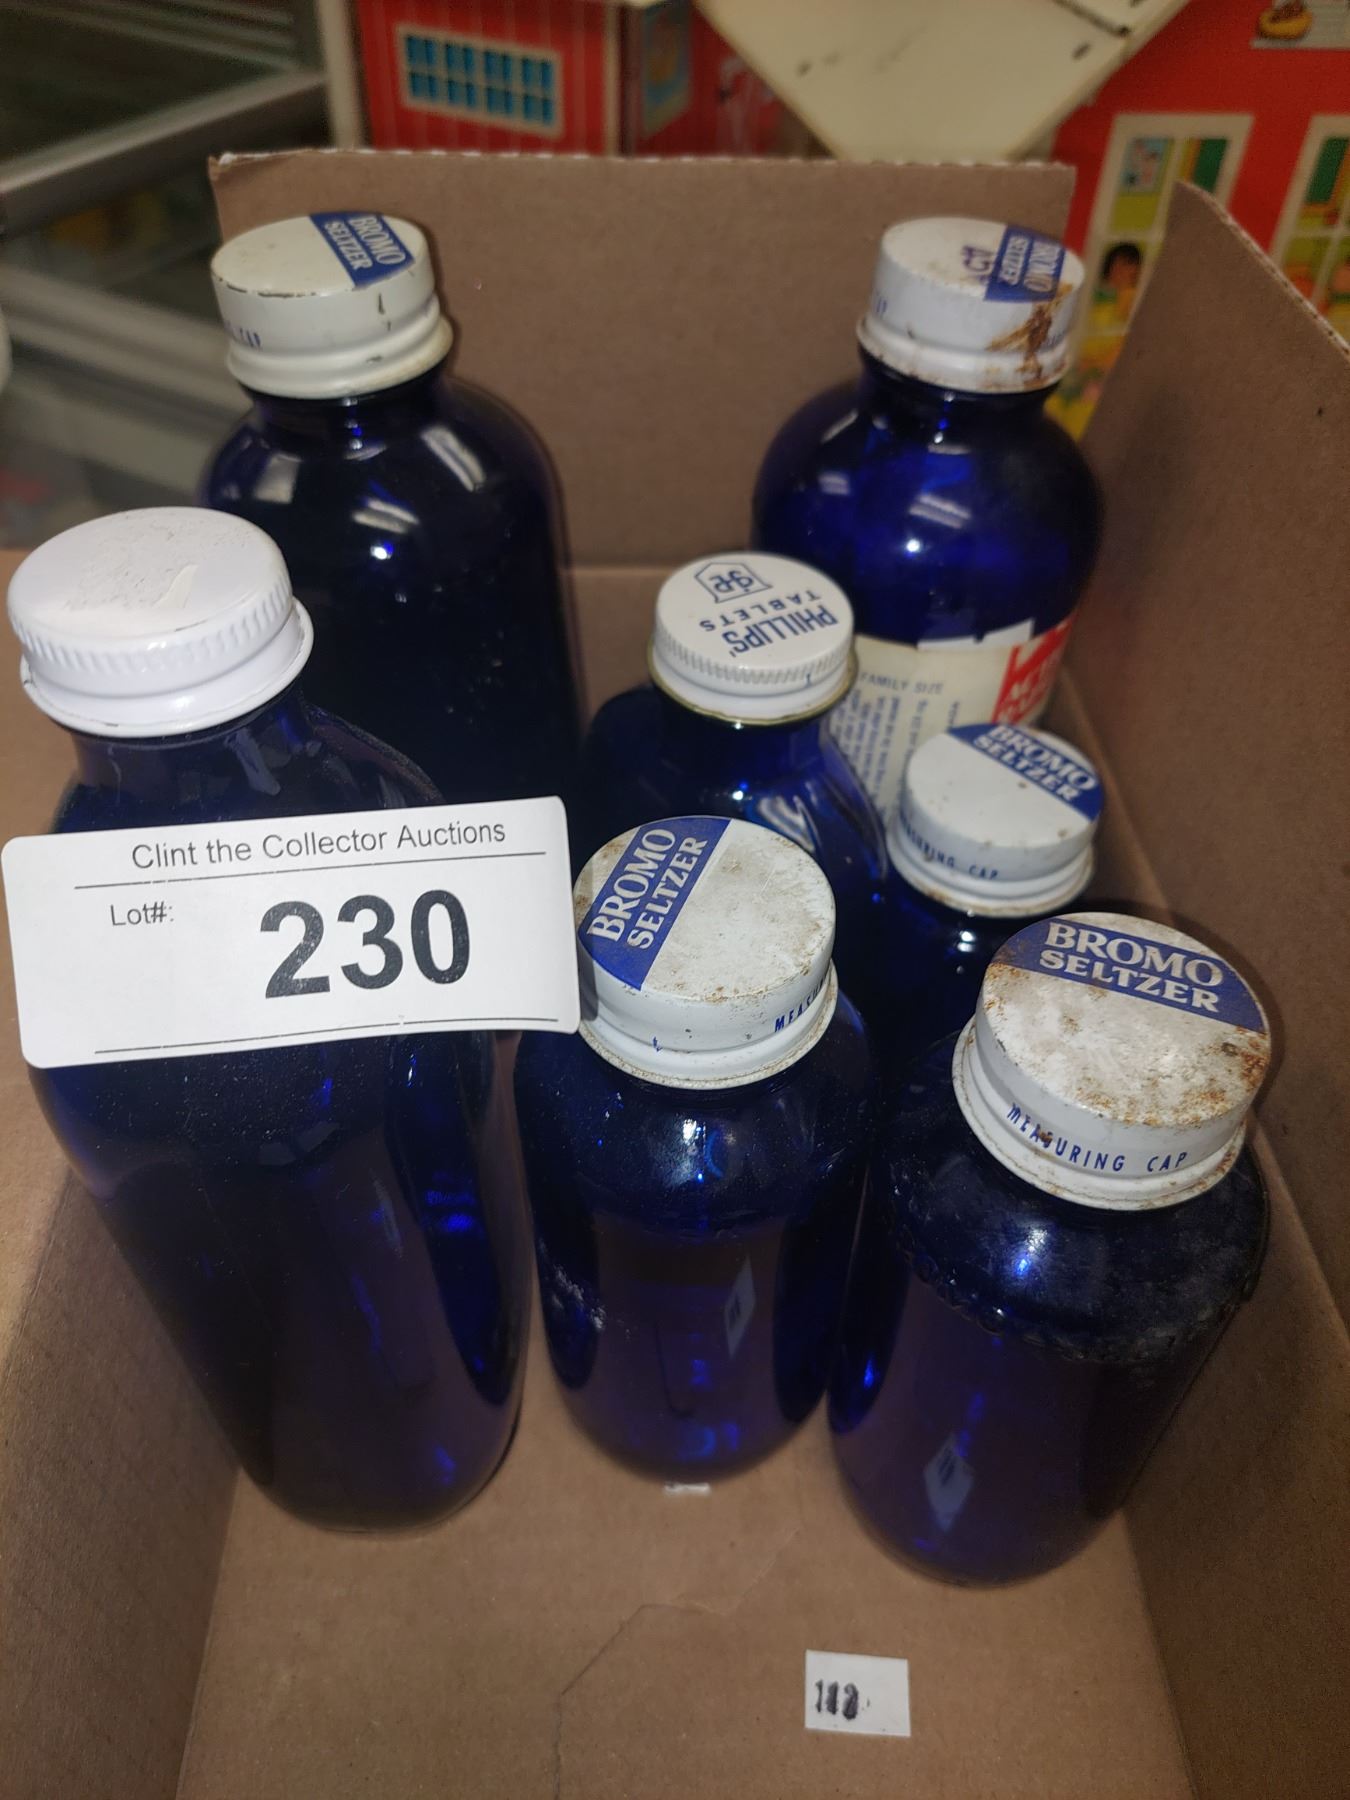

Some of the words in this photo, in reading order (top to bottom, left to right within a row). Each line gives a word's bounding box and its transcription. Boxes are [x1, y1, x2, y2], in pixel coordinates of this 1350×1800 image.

[323, 221, 374, 271] SELTZER
[348, 215, 406, 265] BROMO
[699, 589, 822, 632] TABLETS
[973, 735, 1082, 801] SELTZER
[991, 725, 1097, 790] BROMO
[132, 845, 198, 869] Clint
[206, 839, 252, 862] the
[262, 827, 387, 858] Collector
[396, 820, 506, 849] Auctions
[968, 864, 999, 880] CAP
[110, 900, 174, 927] Lot#:
[587, 829, 676, 942] BROMO
[626, 836, 708, 949] SELTZER
[260, 889, 470, 999] 230
[1045, 922, 1224, 987] BROMO
[1040, 950, 1219, 1013] SELTZER
[1147, 1152, 1188, 1172] CAP
